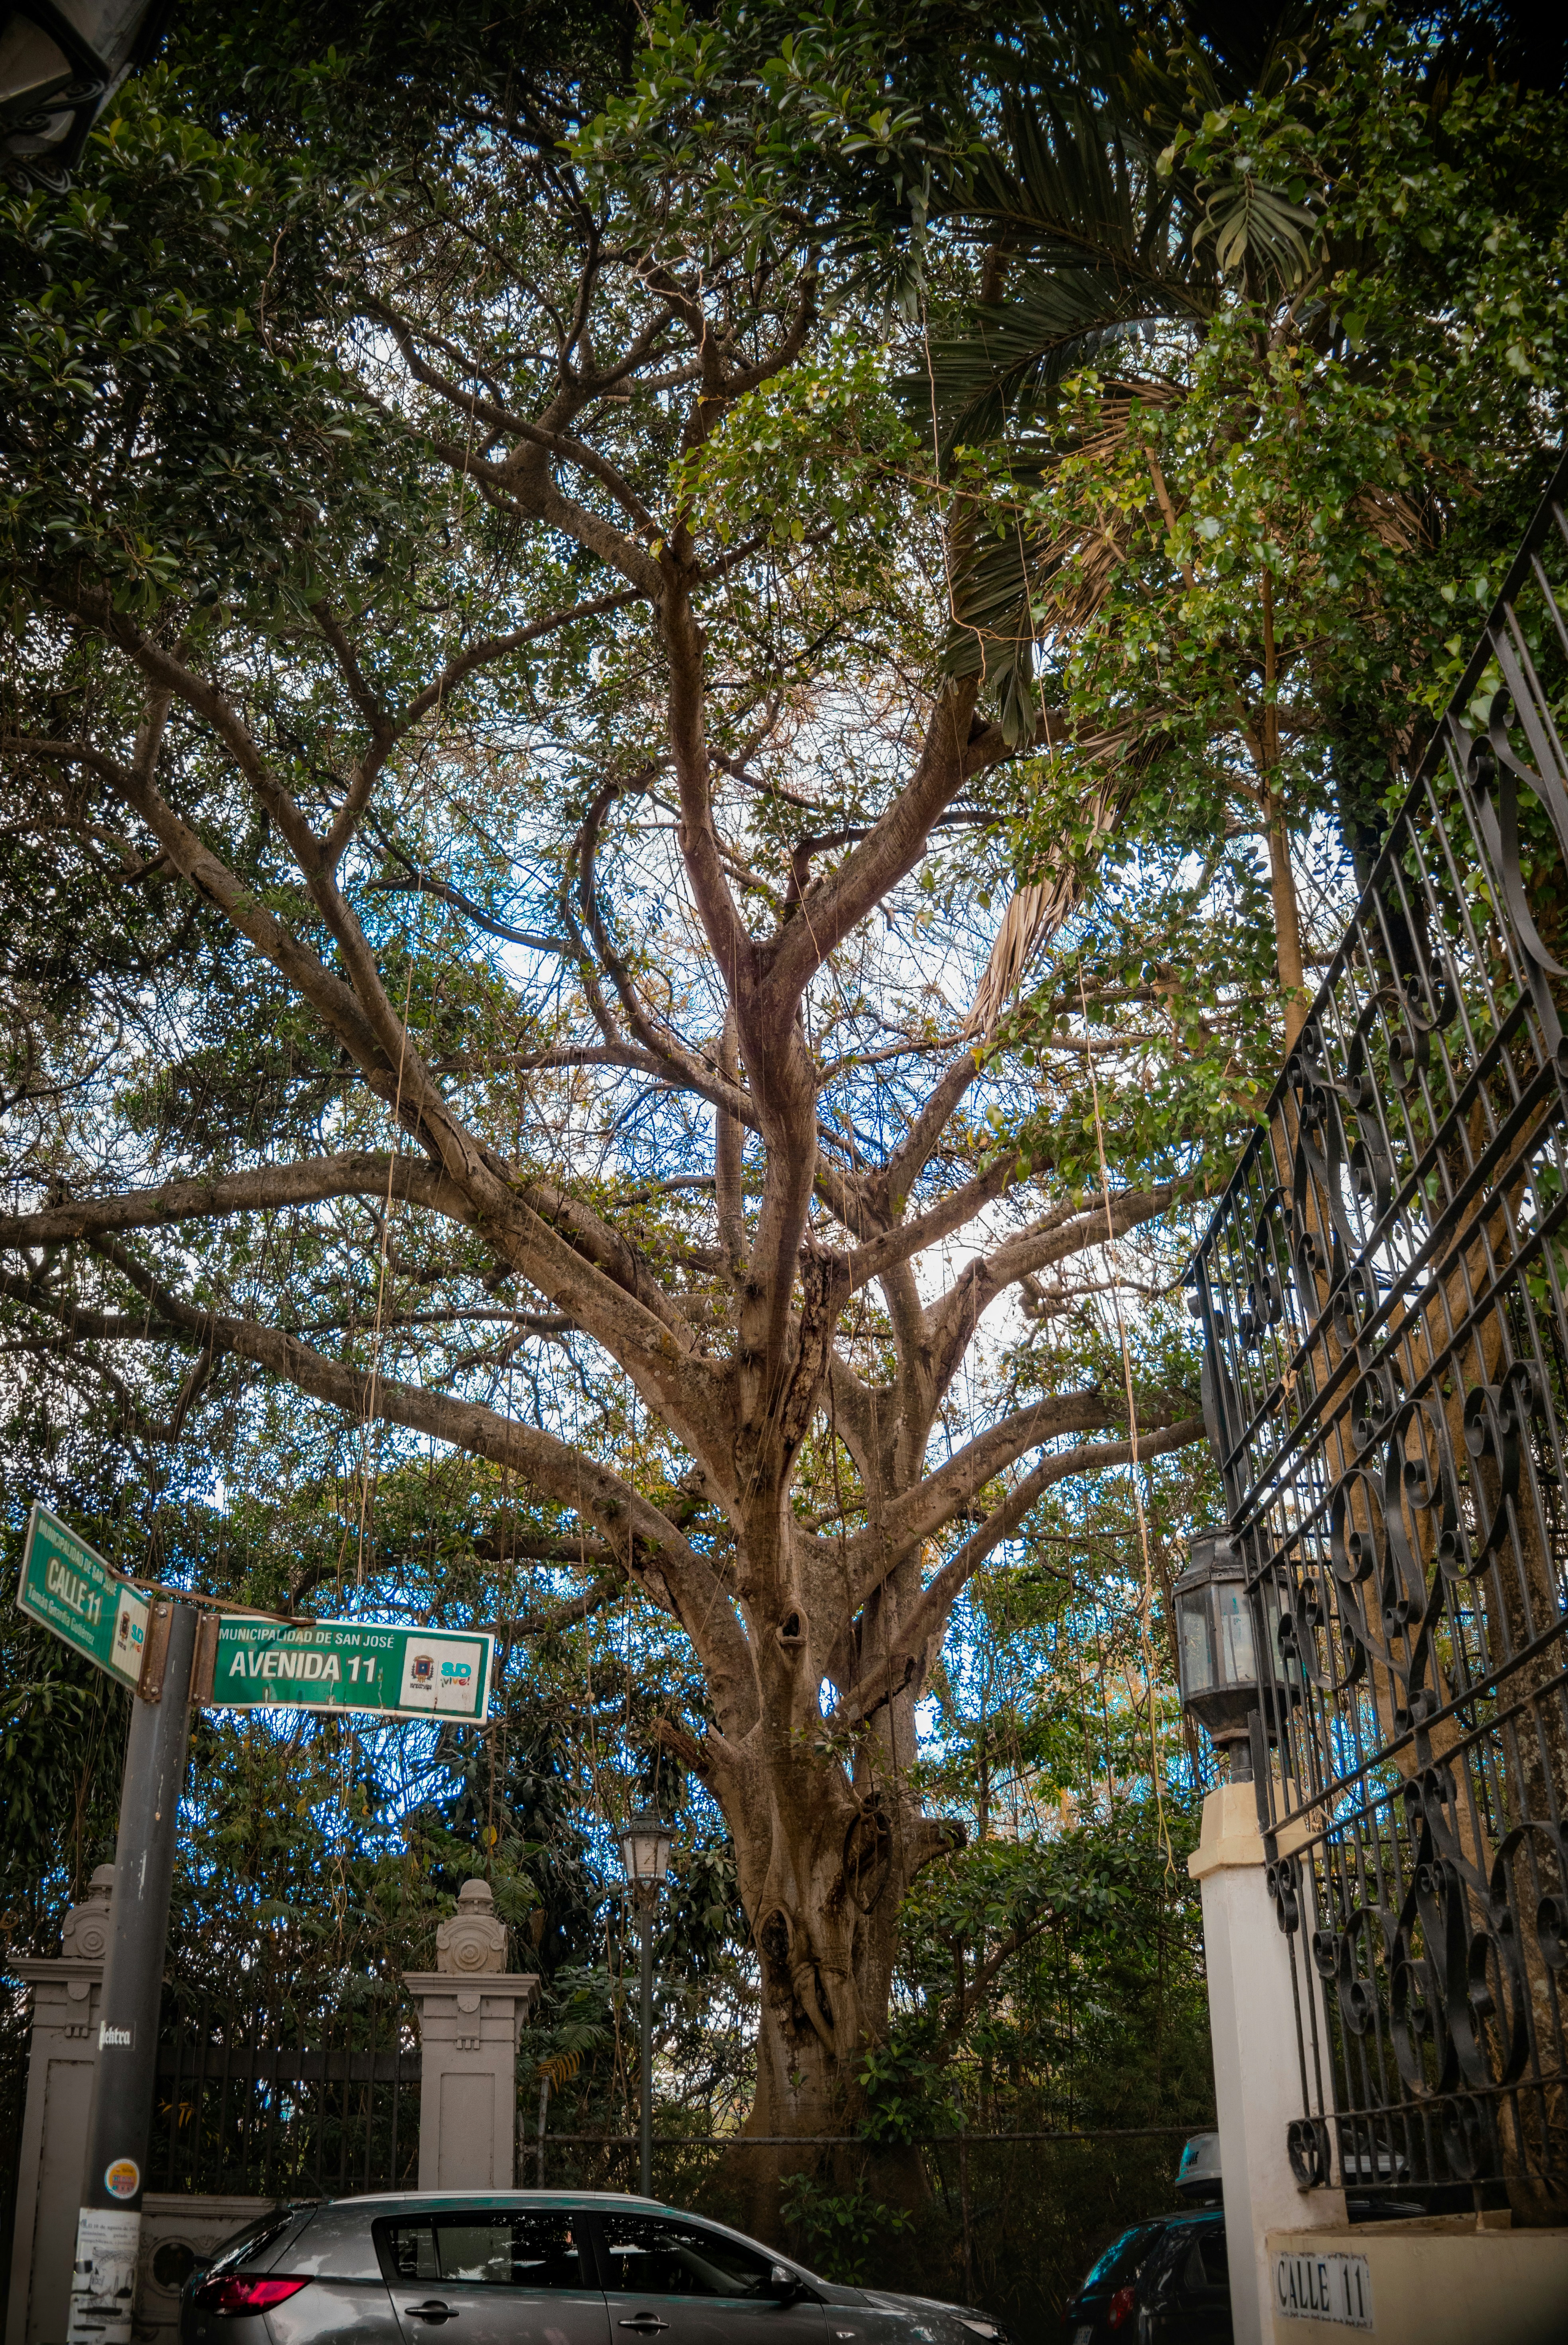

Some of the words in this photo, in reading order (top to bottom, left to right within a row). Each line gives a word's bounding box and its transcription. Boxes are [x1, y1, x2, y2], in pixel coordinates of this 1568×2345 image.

[39, 1519, 84, 1567] MUNICIPALIDAD
[83, 1557, 93, 1574] DE
[92, 1565, 104, 1584] SAN
[28, 1583, 48, 1610] Tomás
[48, 1600, 71, 1627] Guardia
[71, 1617, 95, 1646] Gutiérrez
[48, 1559, 87, 1614] CALLE
[88, 1592, 102, 1625] 11
[219, 1628, 313, 1644] MUNICIPALIDAD
[315, 1631, 333, 1644] DE
[335, 1633, 361, 1646] SAN
[363, 1634, 395, 1649] JOSÉ
[229, 1651, 340, 1681] AVENIDA
[348, 1656, 375, 1682] 11
[101, 2026, 131, 2045] lektra
[1278, 2260, 1330, 2312] CALLE
[1343, 2263, 1364, 2318] 11
